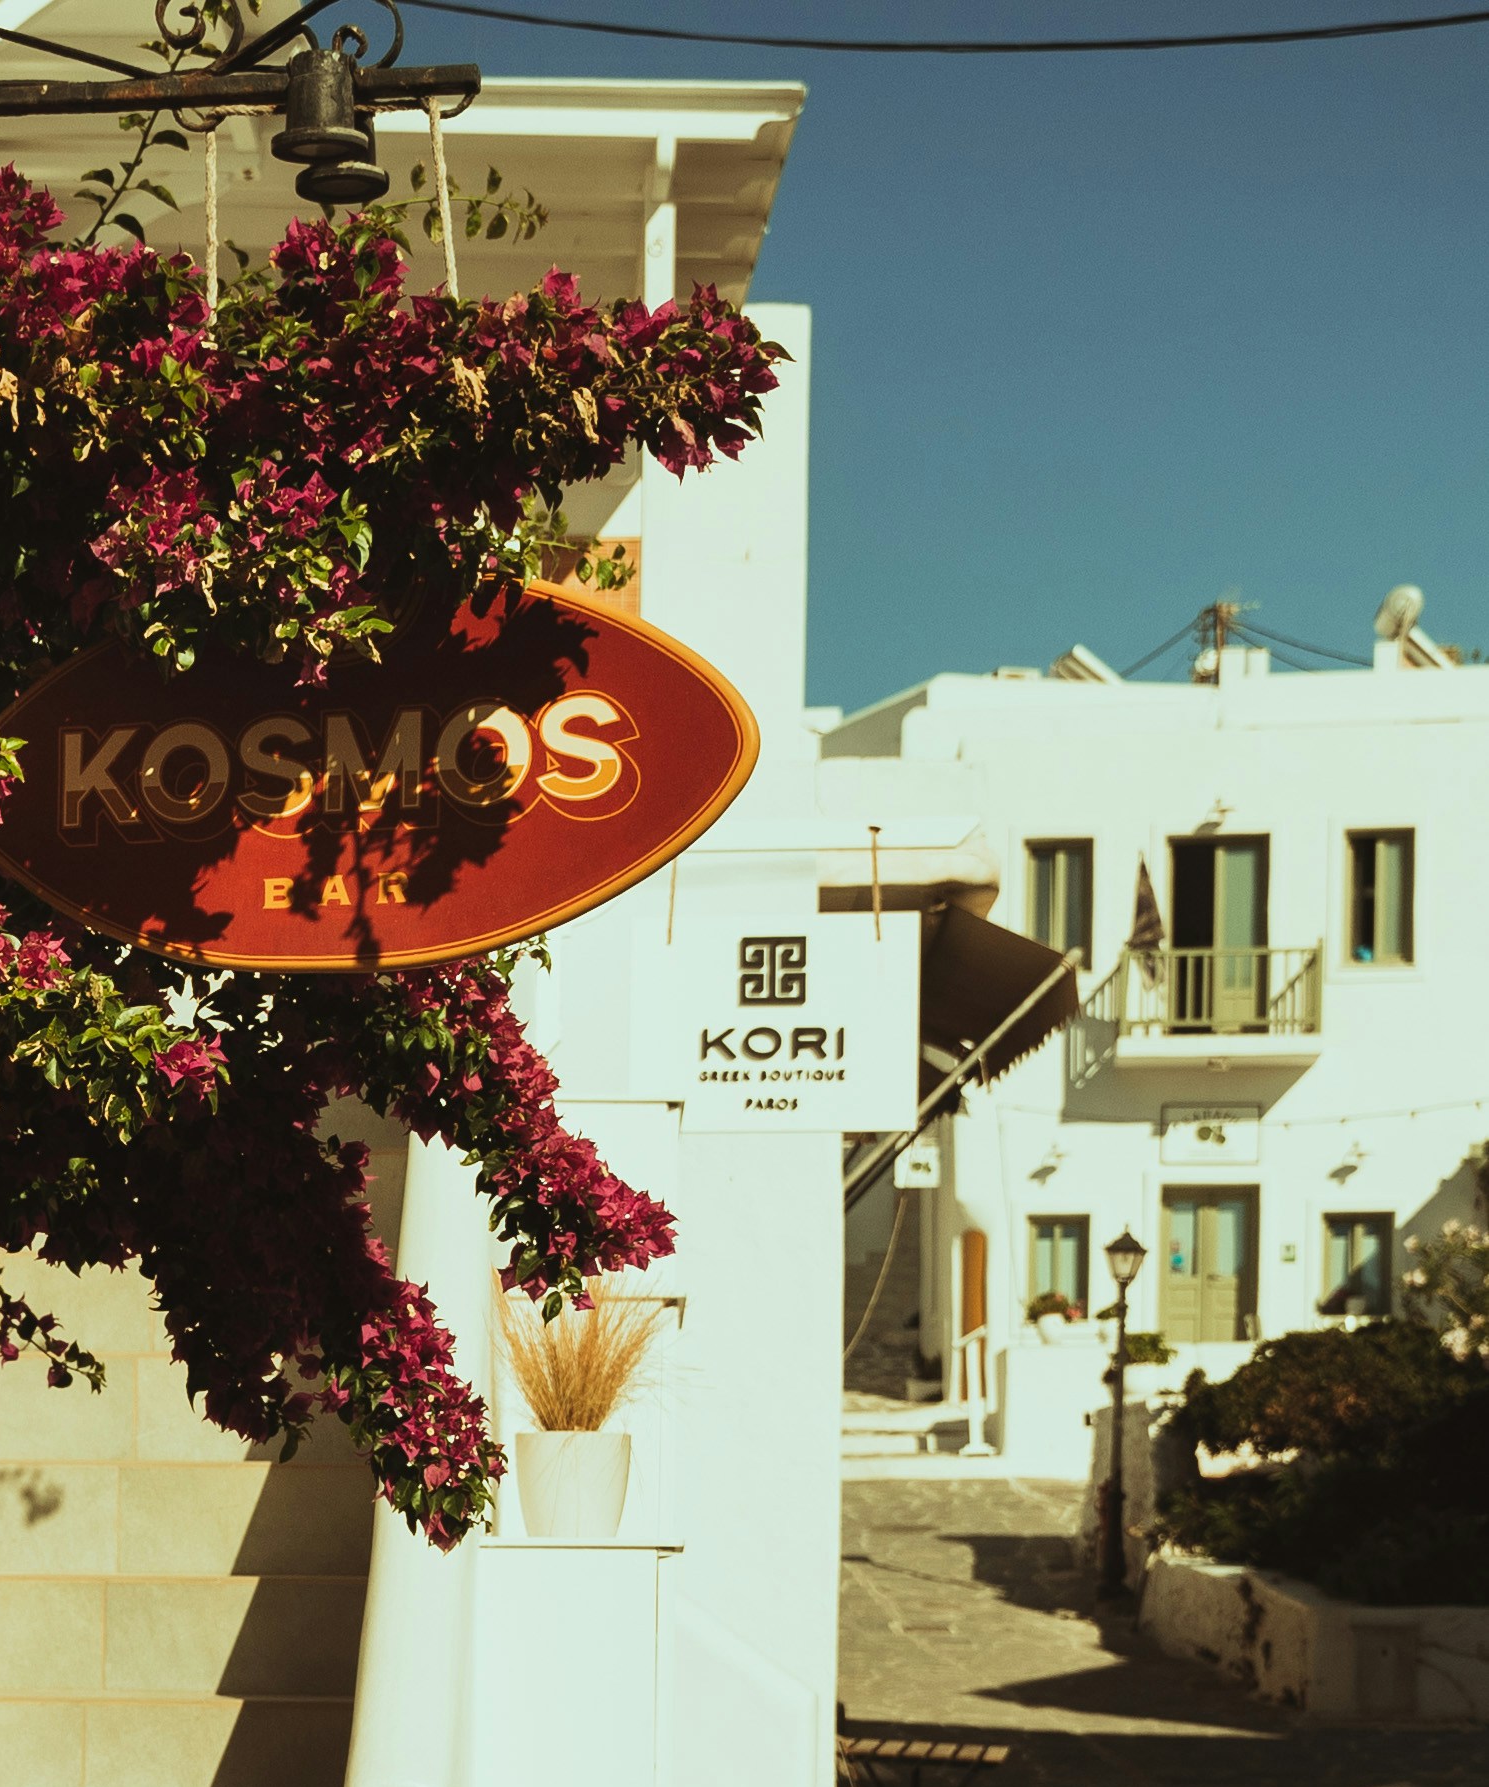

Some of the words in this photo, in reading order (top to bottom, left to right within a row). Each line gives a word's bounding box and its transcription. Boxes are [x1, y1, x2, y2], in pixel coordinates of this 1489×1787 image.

[59, 690, 633, 836] KOSMOS
[262, 872, 409, 910] BAR
[699, 1026, 845, 1061] KORI
[699, 1070, 751, 1082] GREEK
[759, 1069, 846, 1082] BOUTIQUE
[744, 1097, 798, 1111] PAROS
